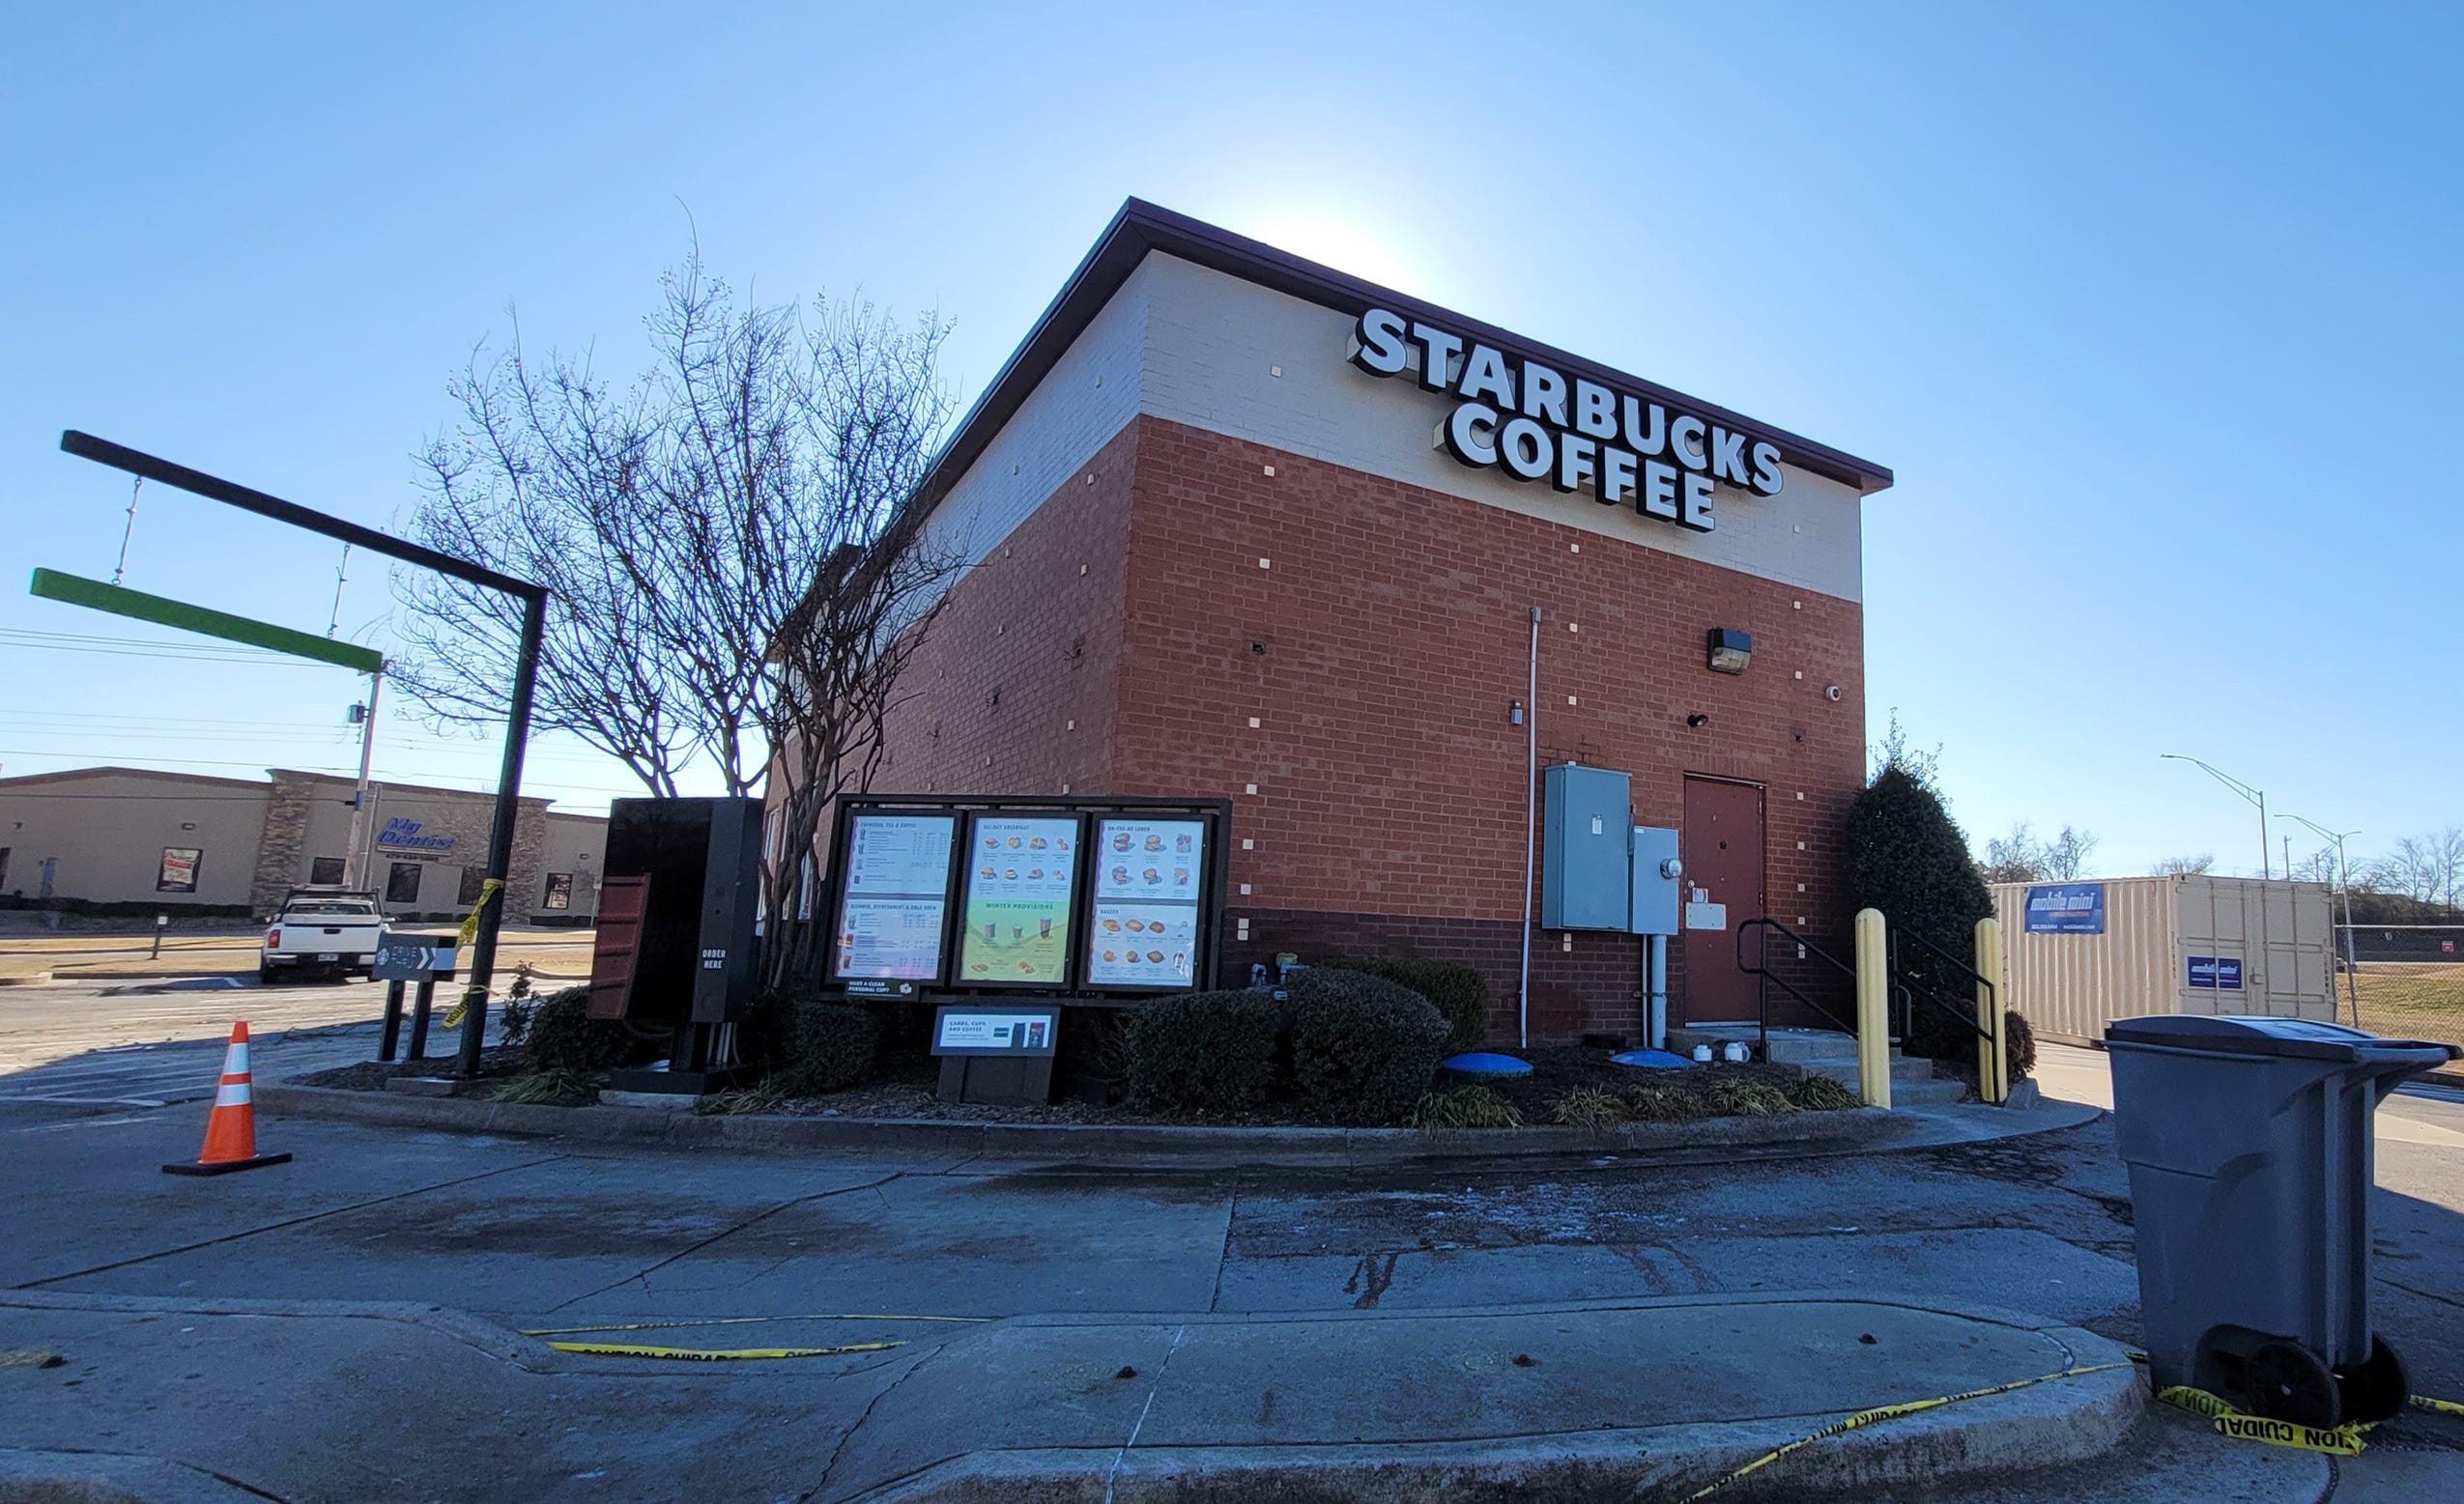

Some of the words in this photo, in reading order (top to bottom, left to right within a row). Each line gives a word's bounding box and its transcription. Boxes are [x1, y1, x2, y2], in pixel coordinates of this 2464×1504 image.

[1356, 307, 1783, 496] STARBUCKS
[1448, 402, 1715, 531] COFFEE
[388, 817, 423, 835] My
[377, 830, 455, 849] Dentist
[2030, 891, 2068, 912] mobile
[2068, 892, 2097, 911] mini
[702, 950, 727, 958] ORDER
[703, 960, 723, 969] HERE
[2220, 966, 2239, 975] mini
